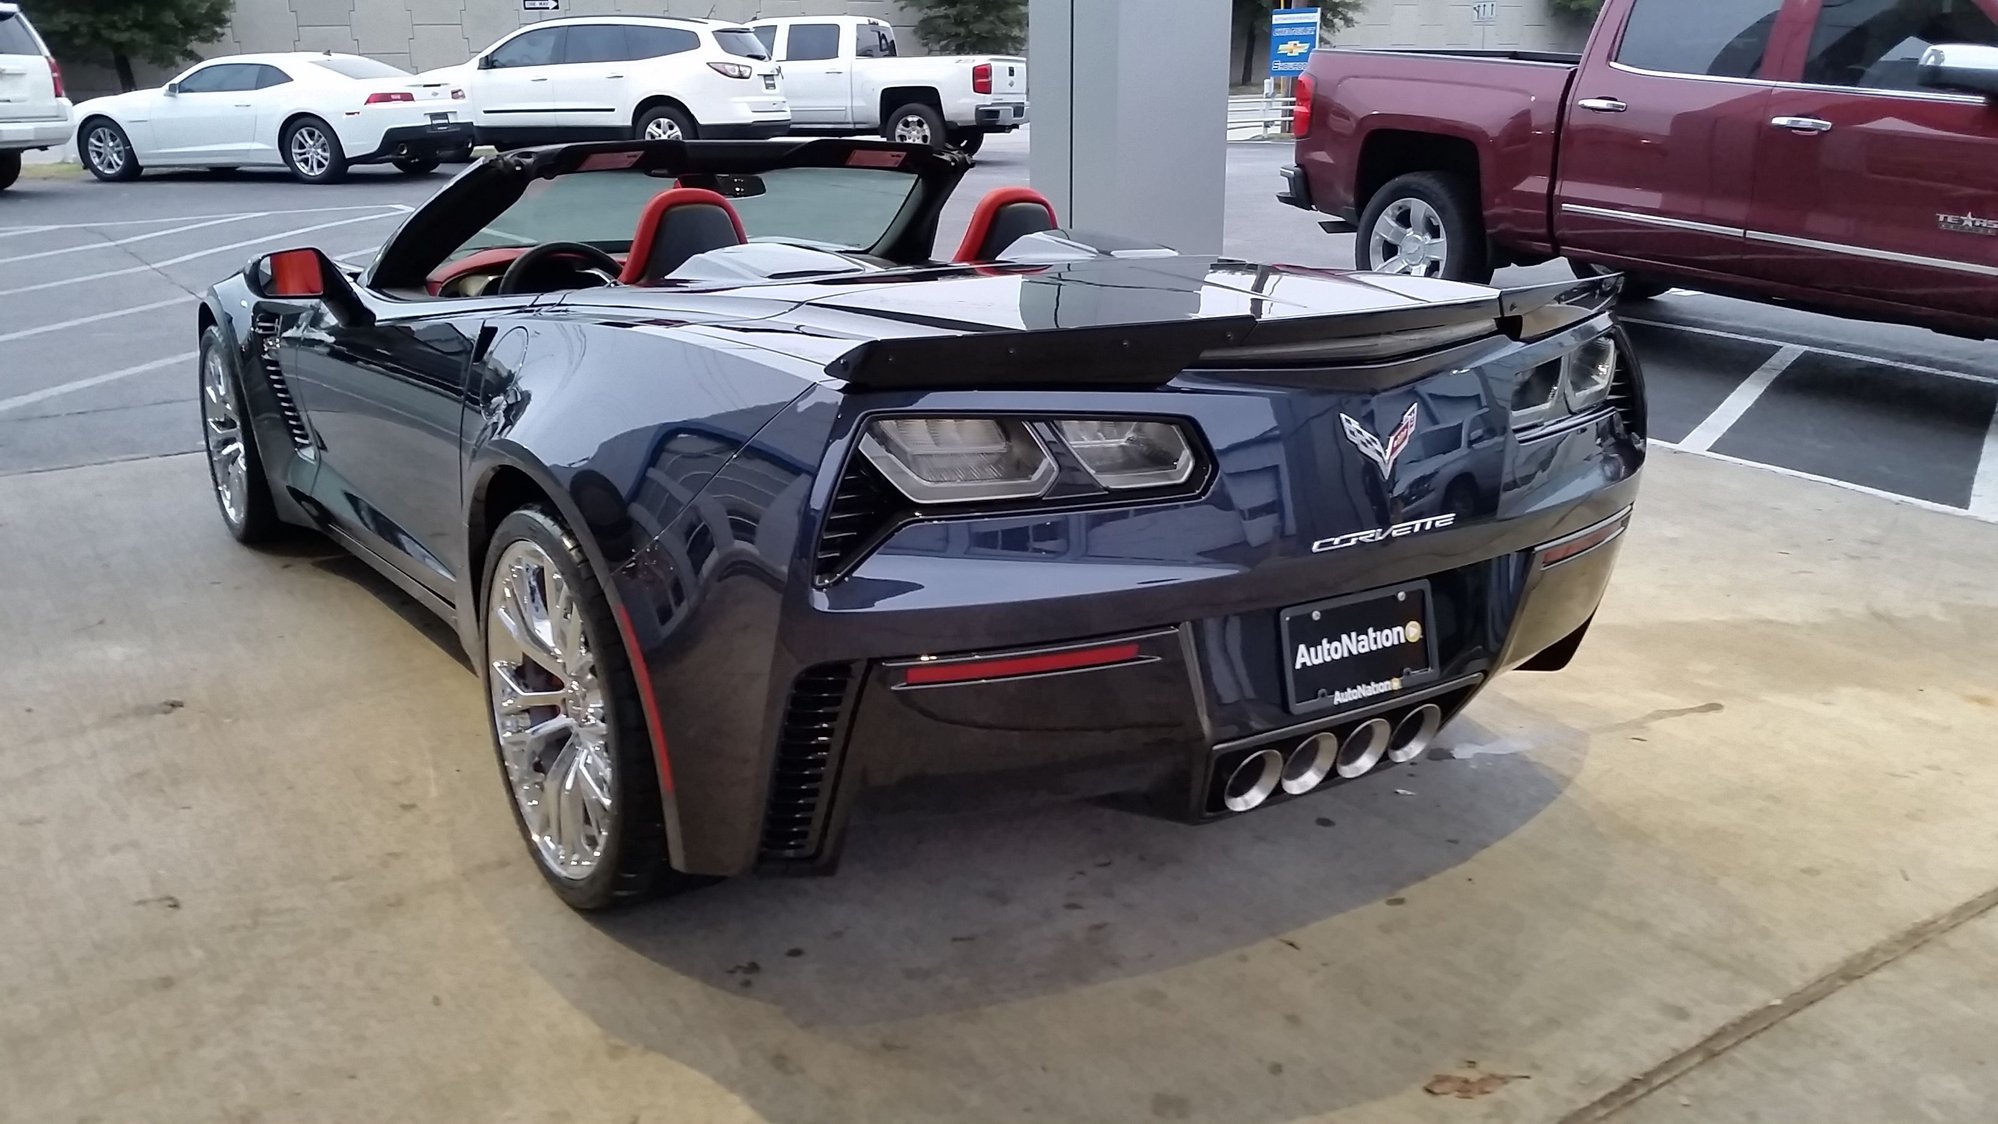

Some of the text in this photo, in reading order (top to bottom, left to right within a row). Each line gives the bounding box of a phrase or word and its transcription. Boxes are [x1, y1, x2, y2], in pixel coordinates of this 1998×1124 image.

[1312, 513, 1456, 553] CORVETTE
[1295, 625, 1406, 669] AutoNation
[1333, 680, 1392, 705] AutoNation
